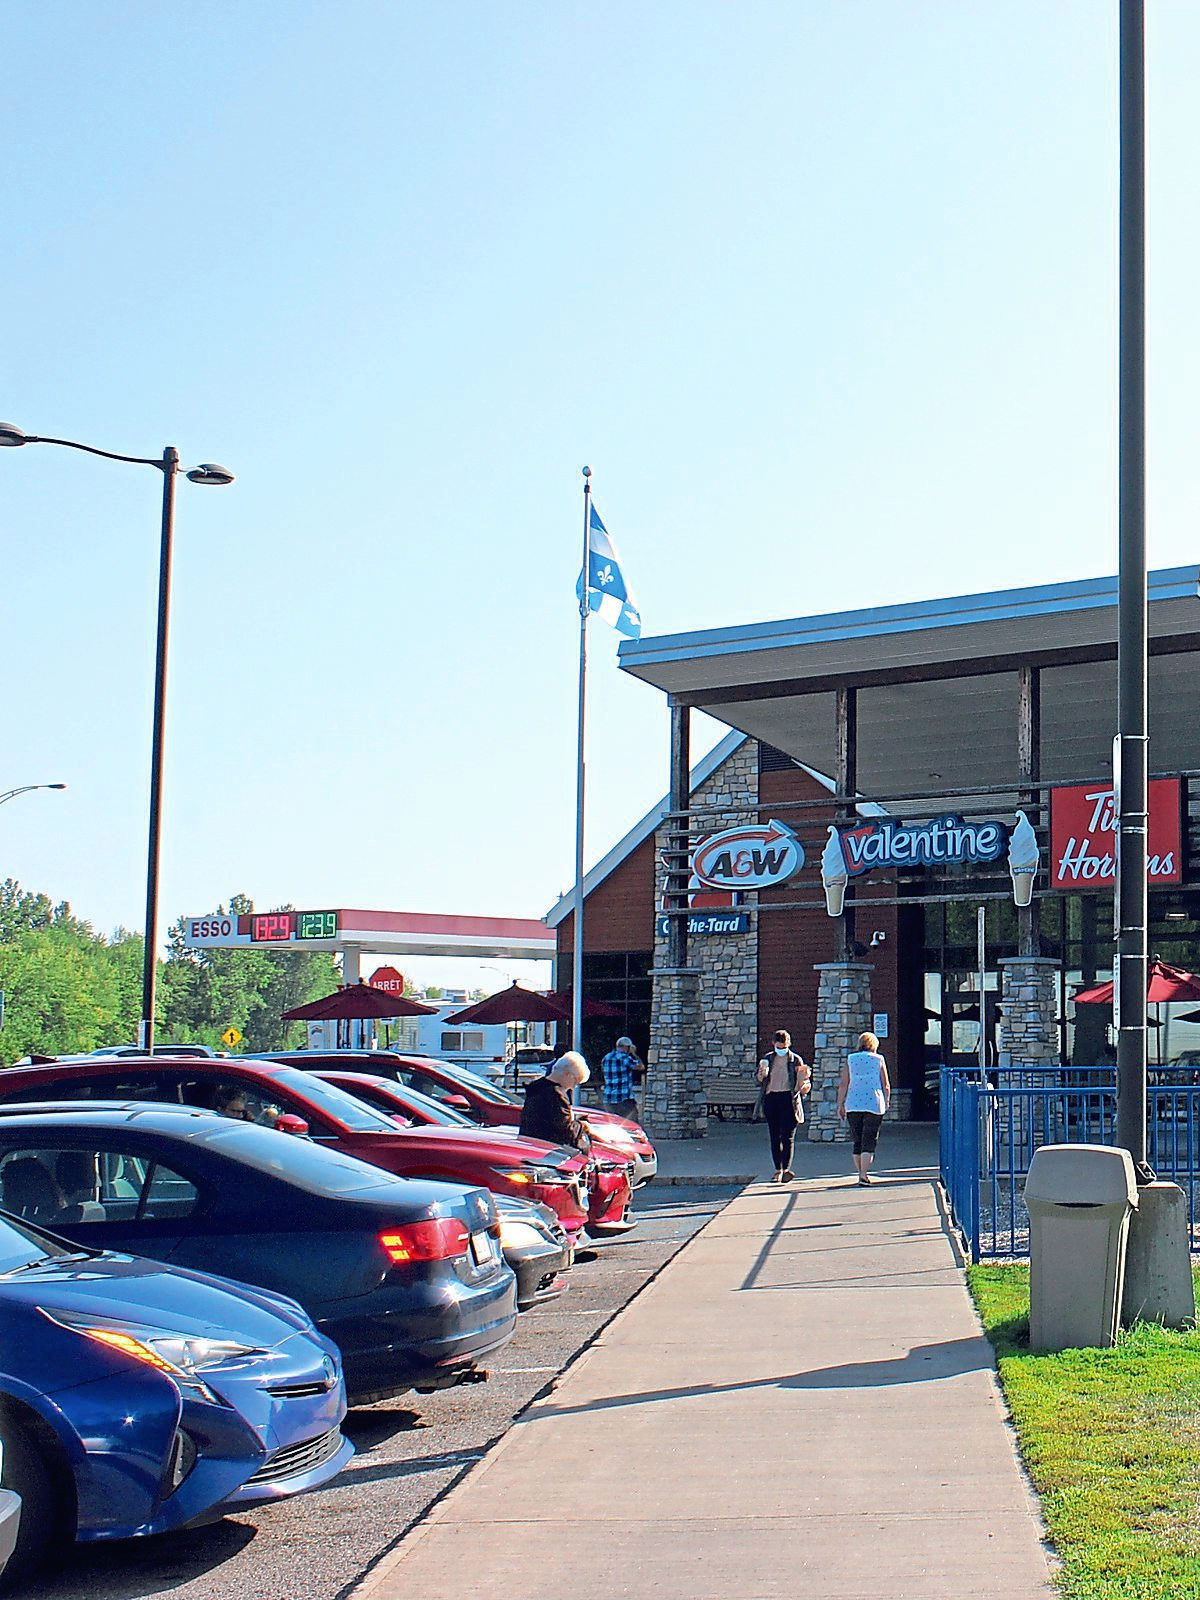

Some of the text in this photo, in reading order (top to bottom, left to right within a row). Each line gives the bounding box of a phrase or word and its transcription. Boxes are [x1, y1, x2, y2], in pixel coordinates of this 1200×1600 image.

[706, 846, 789, 878] A&W
[1057, 837, 1175, 881] Horns
[192, 920, 231, 938] ESSO
[662, 916, 740, 934] Che-Tard
